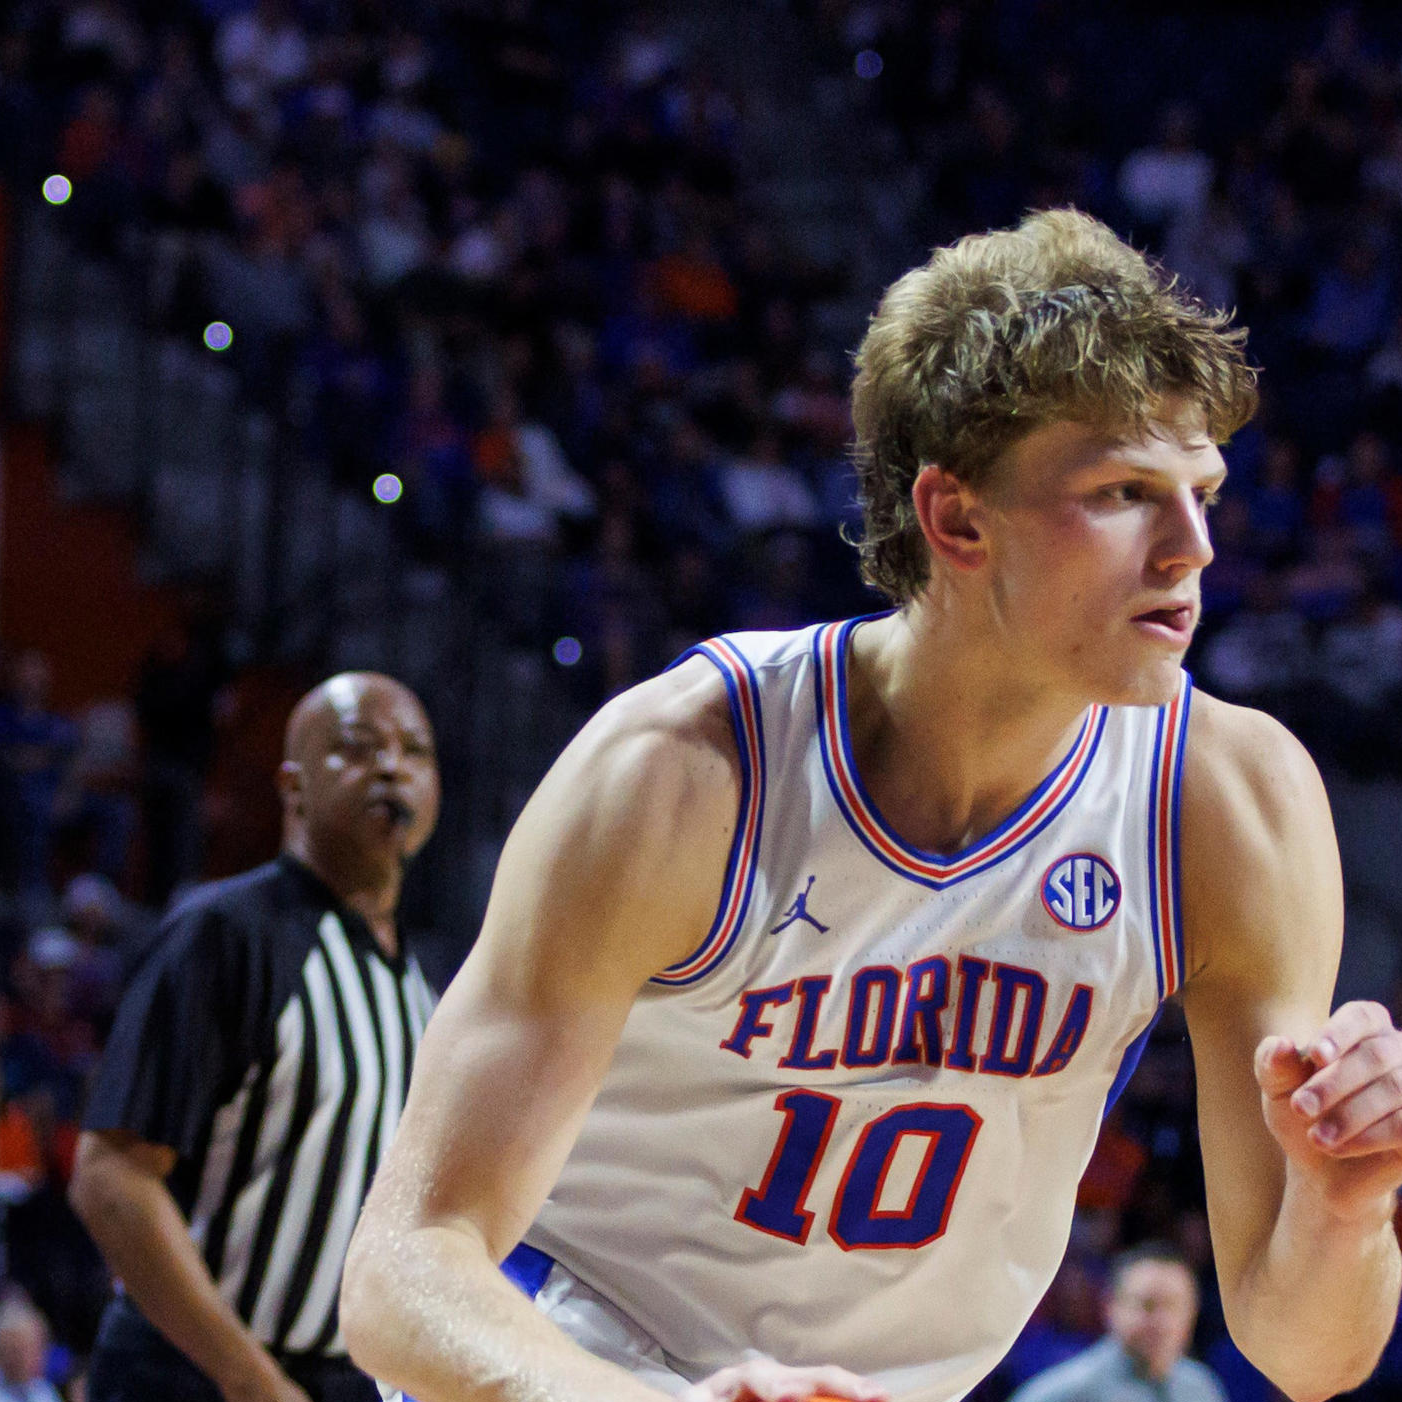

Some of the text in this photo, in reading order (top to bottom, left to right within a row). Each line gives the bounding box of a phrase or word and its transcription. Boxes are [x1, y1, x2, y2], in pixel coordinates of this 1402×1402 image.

[1047, 857, 1116, 929] SEC
[719, 954, 1094, 1078] FLORIDA
[733, 1087, 984, 1253] 10
